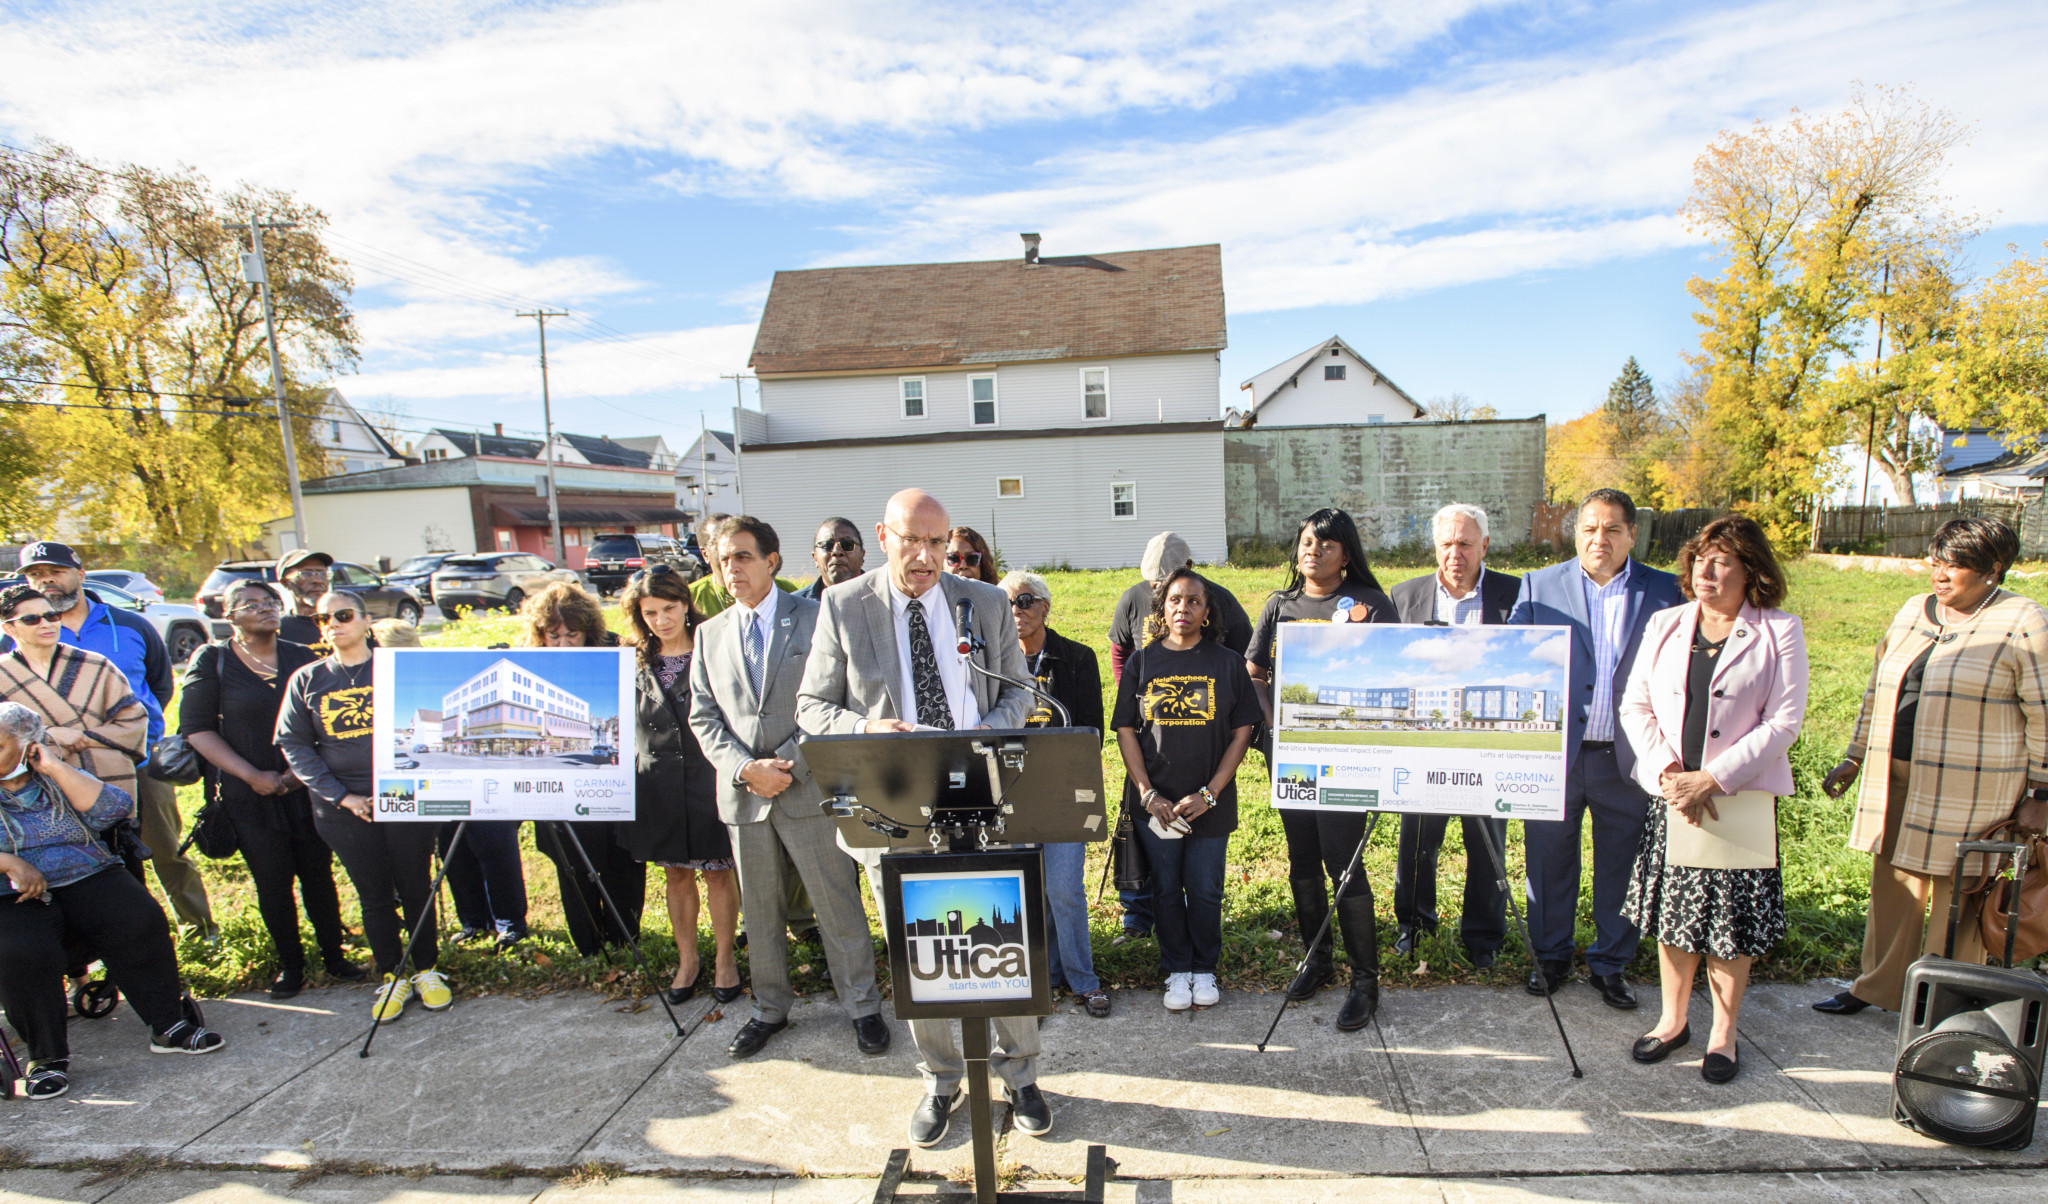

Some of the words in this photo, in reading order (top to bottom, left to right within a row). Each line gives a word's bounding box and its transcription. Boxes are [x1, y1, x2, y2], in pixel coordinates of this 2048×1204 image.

[1153, 674, 1208, 684] Neighborhood
[328, 686, 374, 698] Neighborh
[1208, 678, 1217, 720] Preservation
[1143, 703, 1154, 721] Mid
[1506, 752, 1543, 760] Upthegrove
[1335, 765, 1382, 773] COMMUNITY
[1426, 771, 1483, 786] MID-UTICA
[513, 781, 564, 793] MID-UTICA
[1277, 783, 1316, 801] Utica
[1495, 783, 1540, 794] WOOD
[574, 789, 614, 798] WOOD
[379, 798, 415, 813] Utica
[908, 938, 1028, 981] Utica
[978, 980, 1001, 990] with
[1003, 978, 1030, 989] YOU
